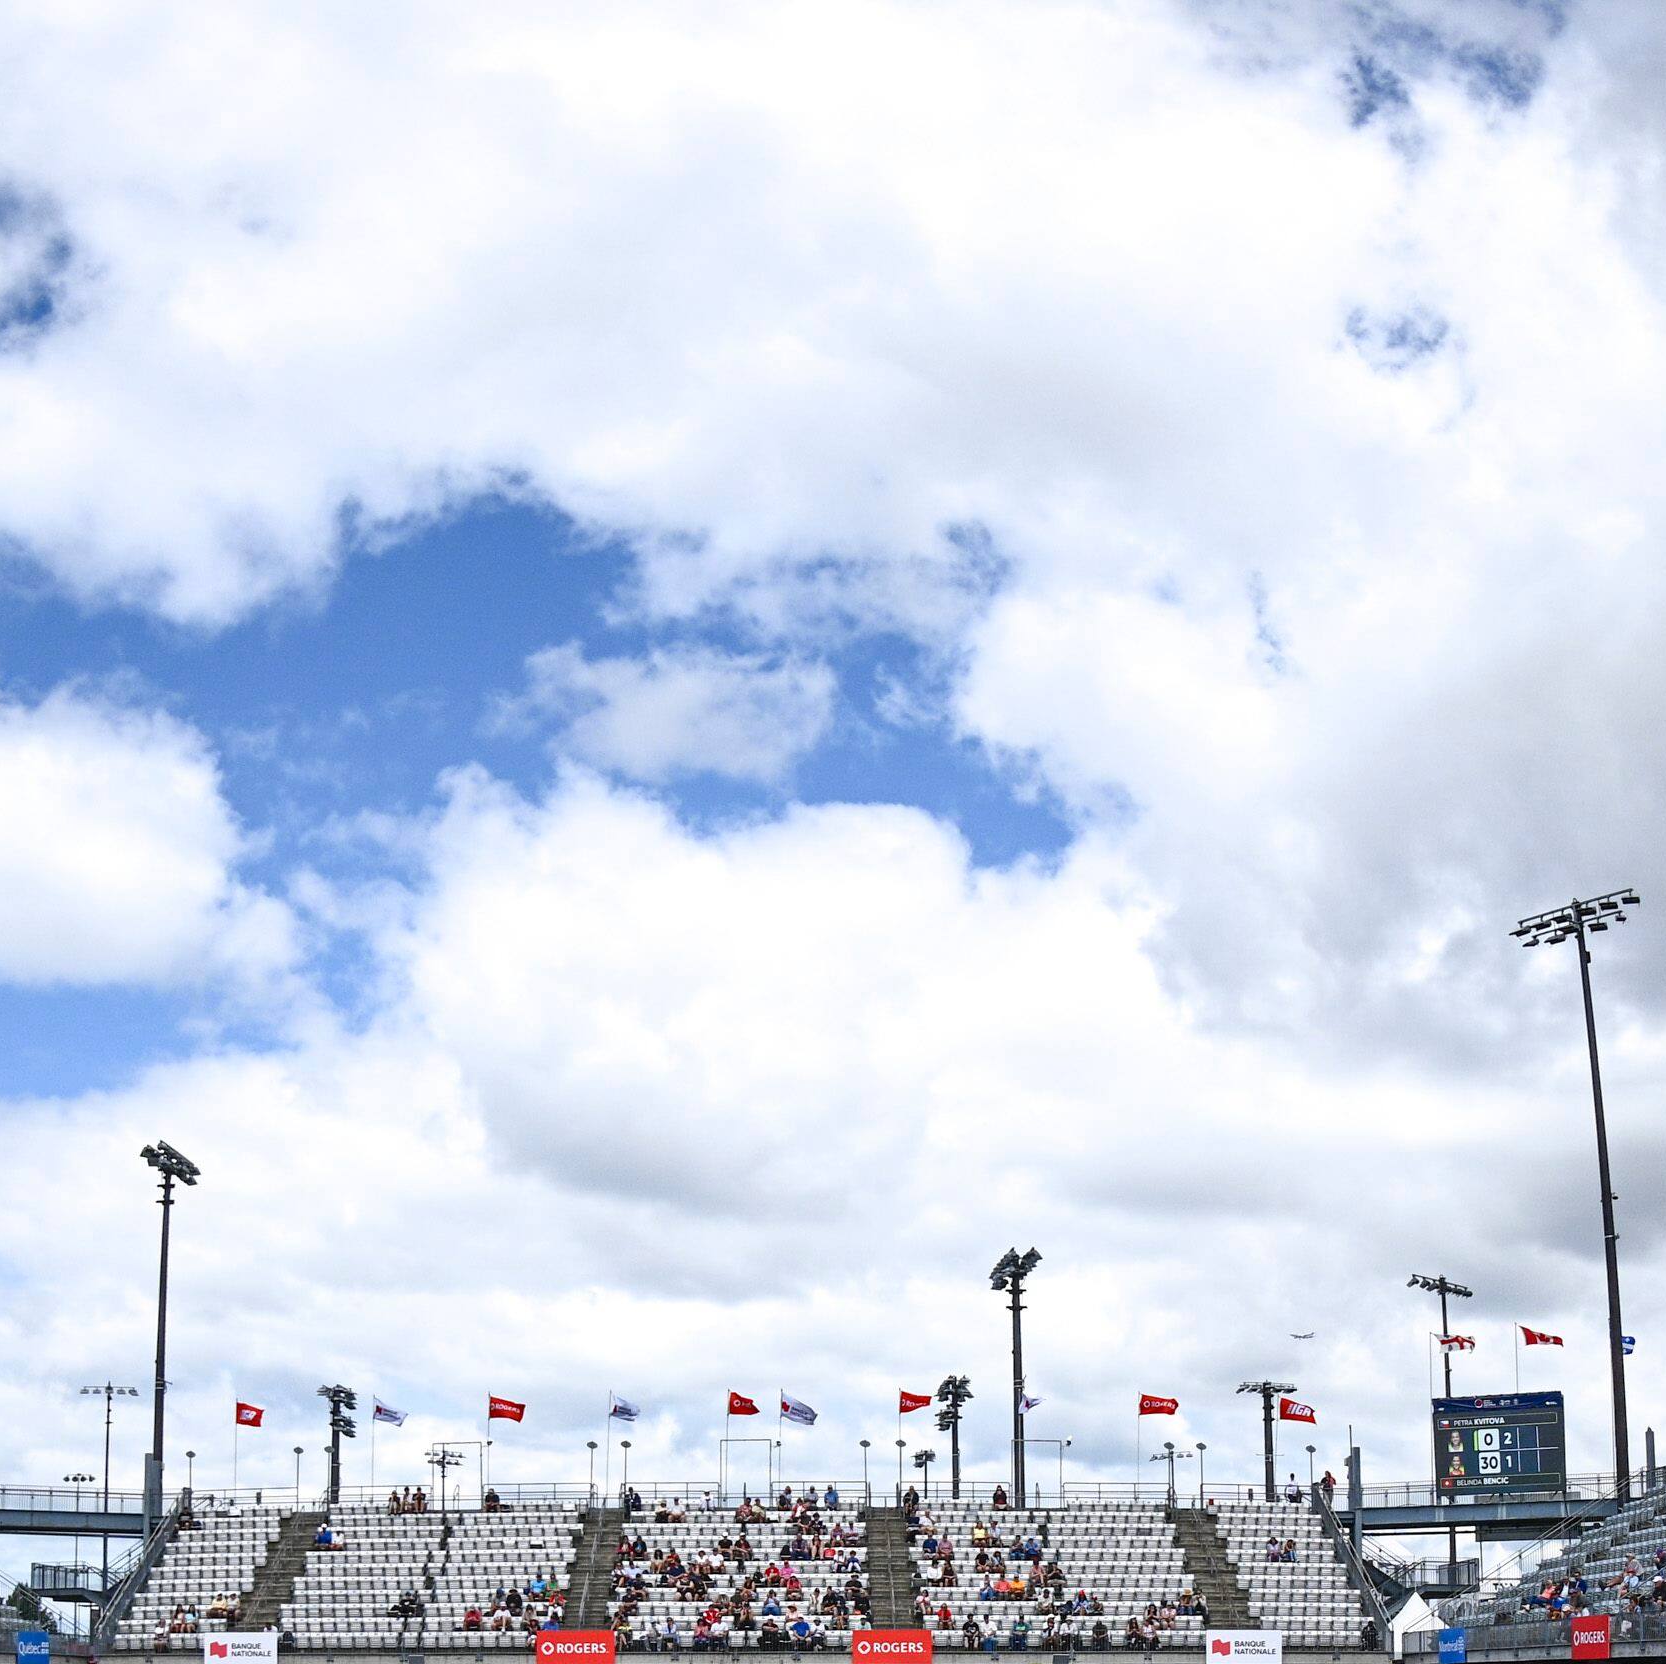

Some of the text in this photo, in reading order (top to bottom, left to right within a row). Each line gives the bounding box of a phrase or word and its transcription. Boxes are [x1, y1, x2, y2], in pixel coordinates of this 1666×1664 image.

[1473, 1417, 1505, 1425] KVITOVA
[1484, 1433, 1512, 1446] 0 2
[1480, 1456, 1512, 1469] 30 1
[1579, 1631, 1606, 1644] ROGERS
[231, 1642, 262, 1650] BANQUE
[556, 1642, 607, 1654] ROGERS
[873, 1641, 924, 1653] ROGERS
[1234, 1640, 1267, 1648] BANQUE
[1234, 1648, 1277, 1656] NATIONALE
